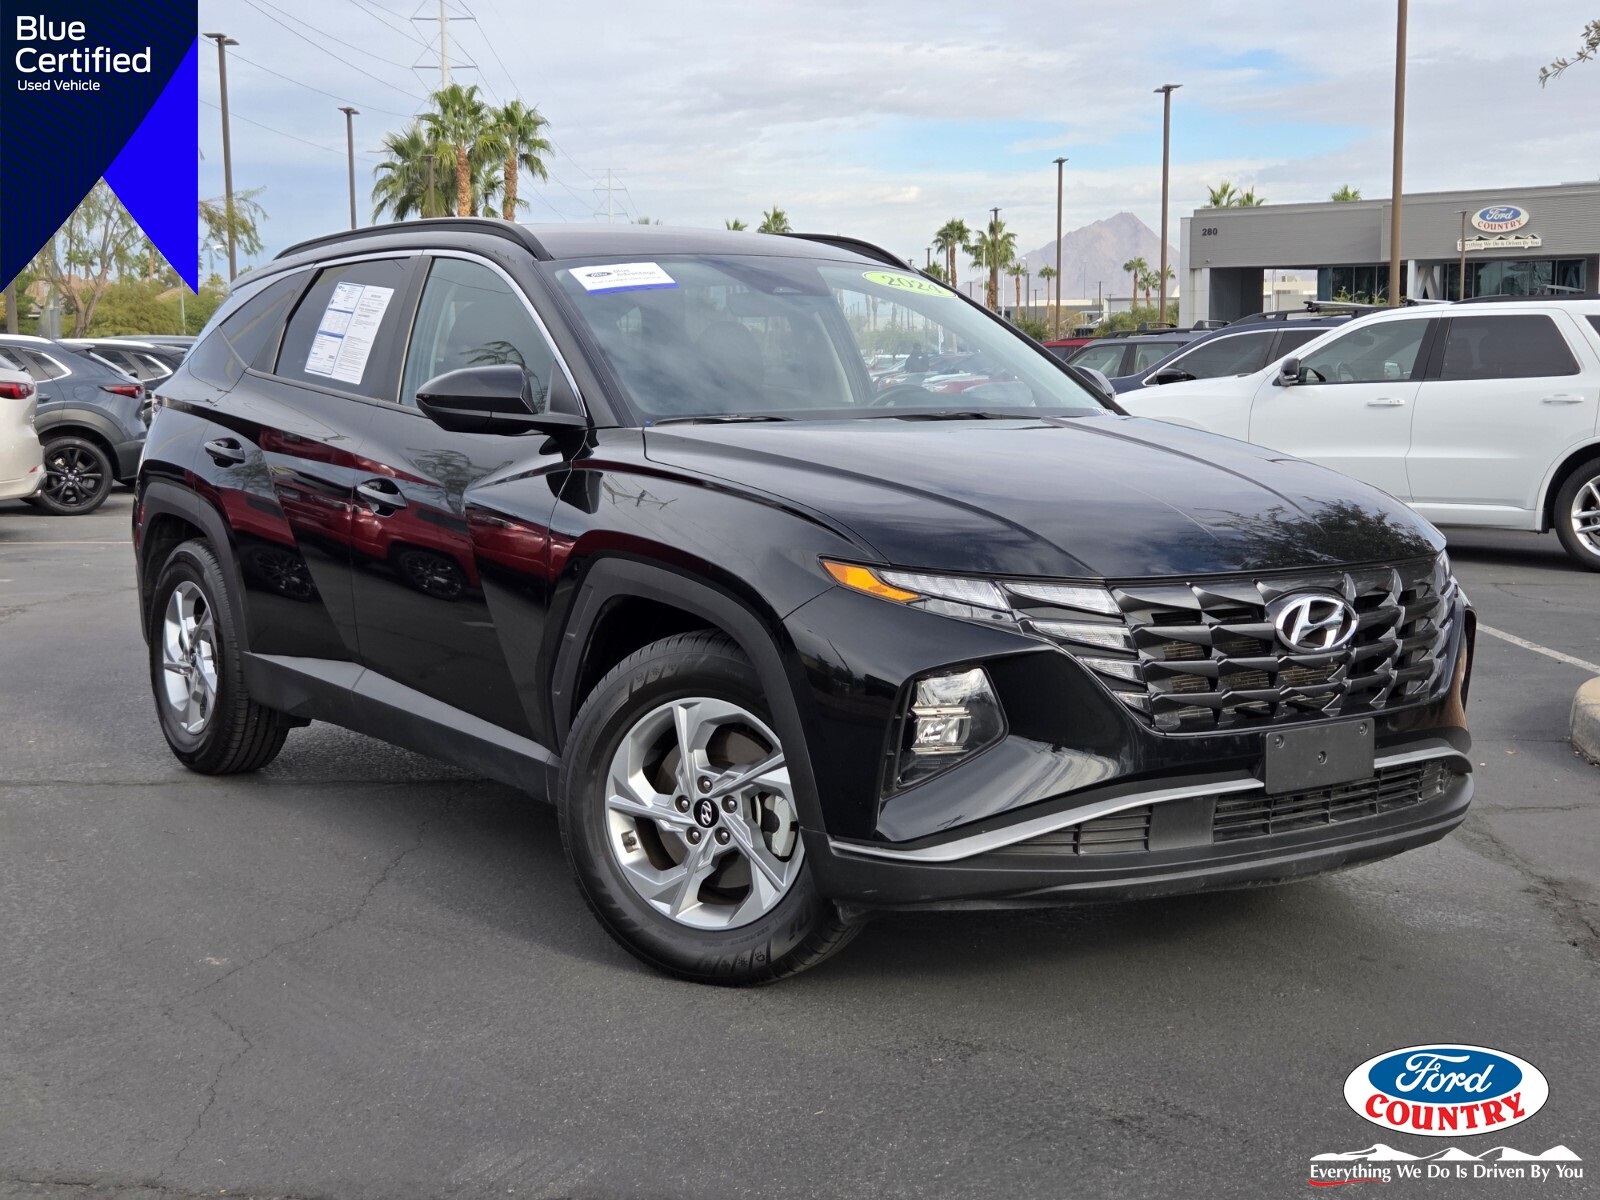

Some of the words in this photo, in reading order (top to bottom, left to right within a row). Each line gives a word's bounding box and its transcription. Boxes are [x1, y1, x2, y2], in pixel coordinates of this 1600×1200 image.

[1485, 207, 1513, 220] Ford
[1477, 218, 1522, 231] COUNTRY
[1201, 227, 1218, 236] 280
[1458, 240, 1483, 249] Erything
